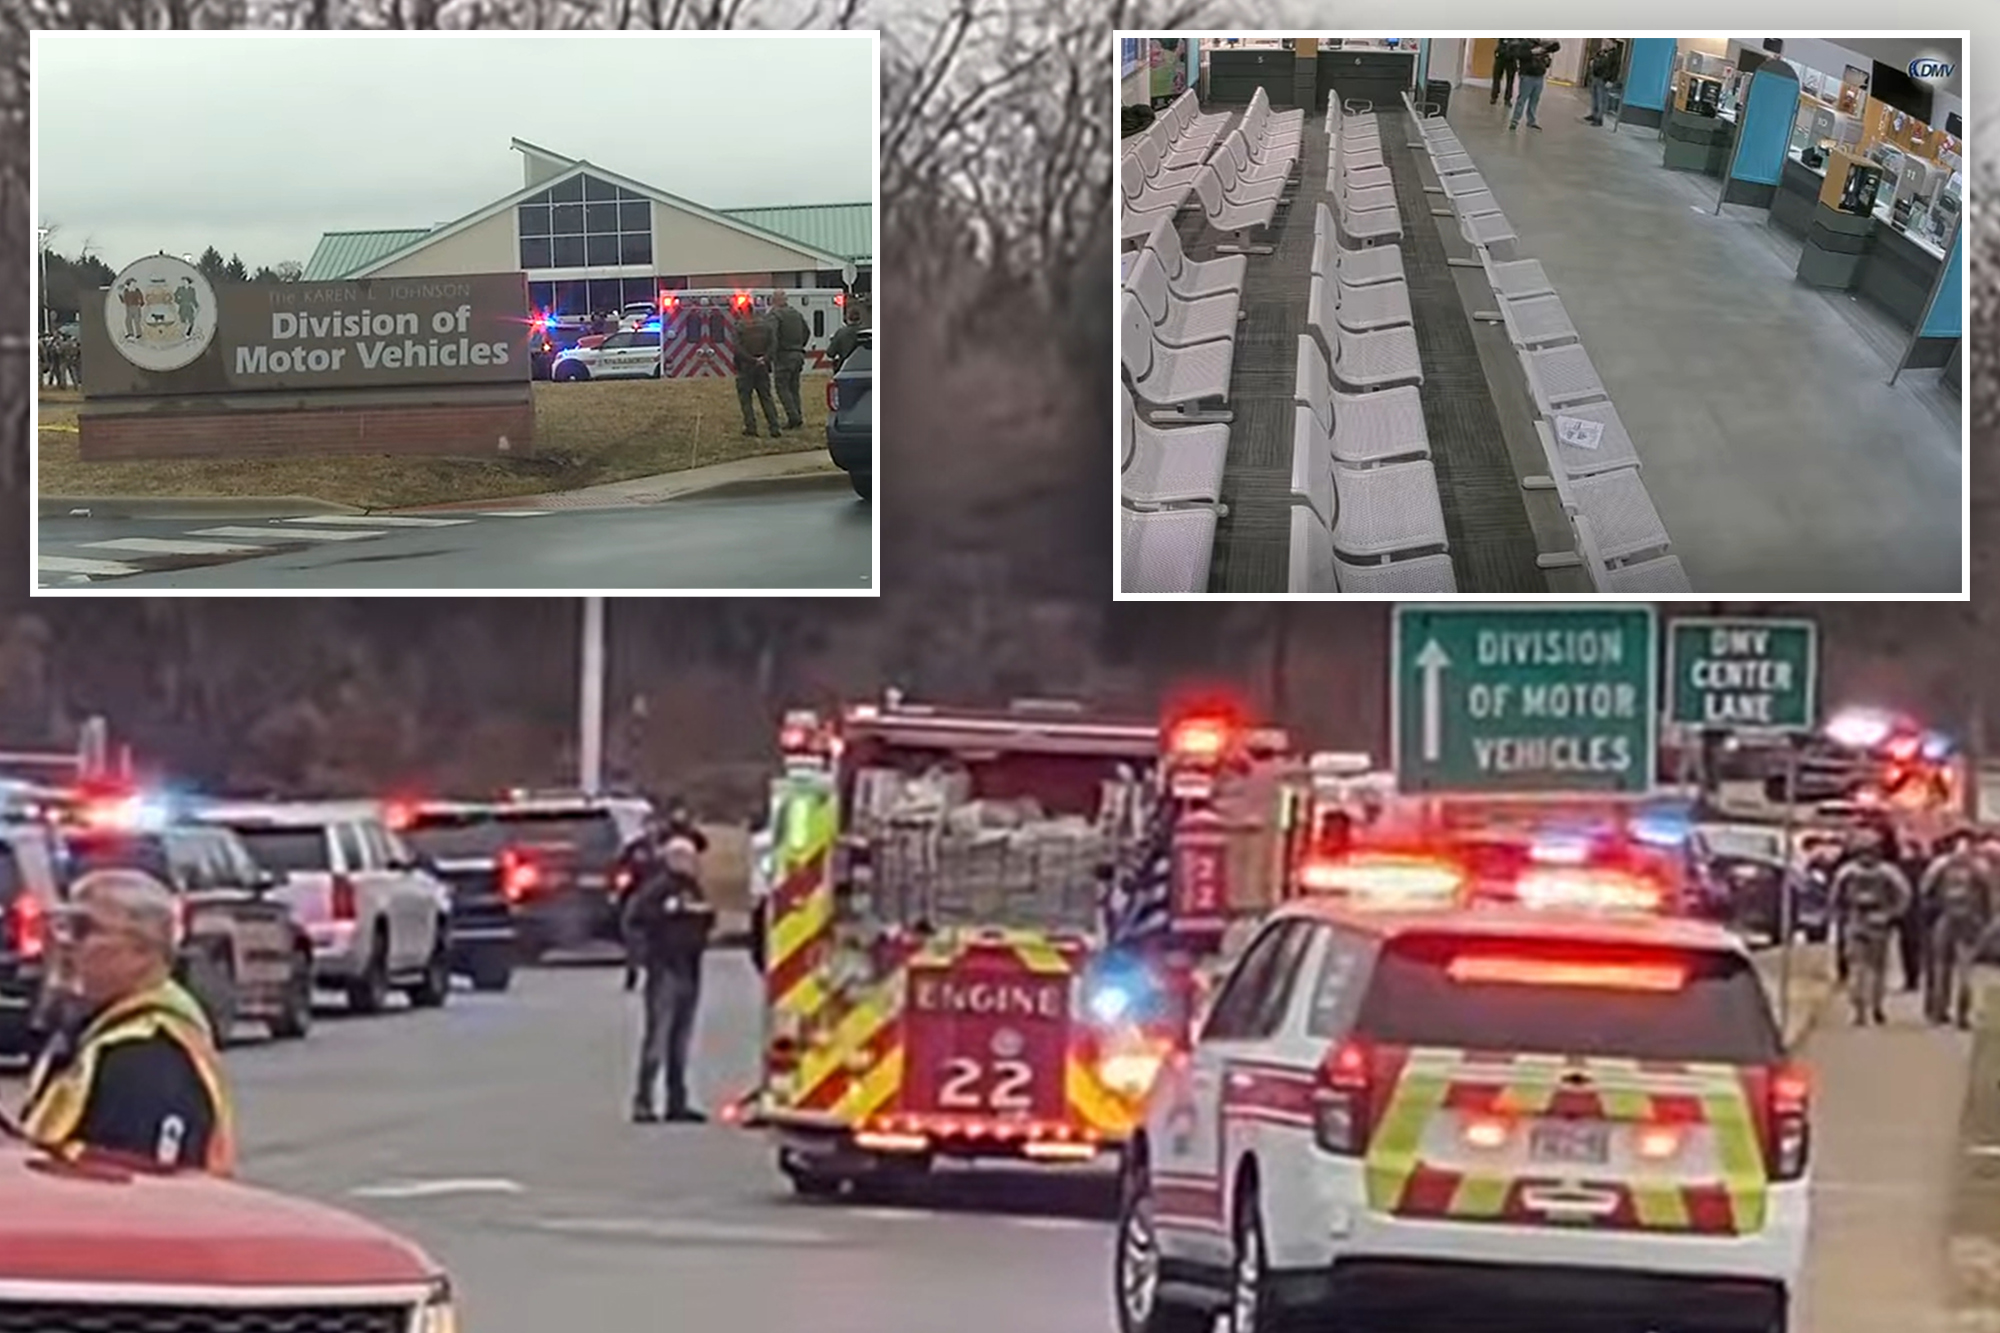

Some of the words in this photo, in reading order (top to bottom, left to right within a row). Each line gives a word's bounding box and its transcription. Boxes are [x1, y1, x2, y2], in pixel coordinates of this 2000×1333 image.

[304, 289, 356, 303] KAREN
[390, 284, 470, 299] JOHNSON
[272, 310, 419, 339] Division
[432, 305, 471, 333] of
[236, 346, 345, 374] Motor
[356, 338, 509, 369] Vehicles
[1477, 631, 1622, 665] DIVISION
[1711, 630, 1770, 655] DMV
[1691, 659, 1791, 691] CENTER
[1469, 684, 1508, 717] OF
[1523, 684, 1635, 718] MOTOR
[1705, 694, 1773, 722] LANE
[1472, 737, 1630, 771] VEHICLES
[916, 981, 1060, 1016] ENGINE
[939, 1057, 1033, 1108] 22
